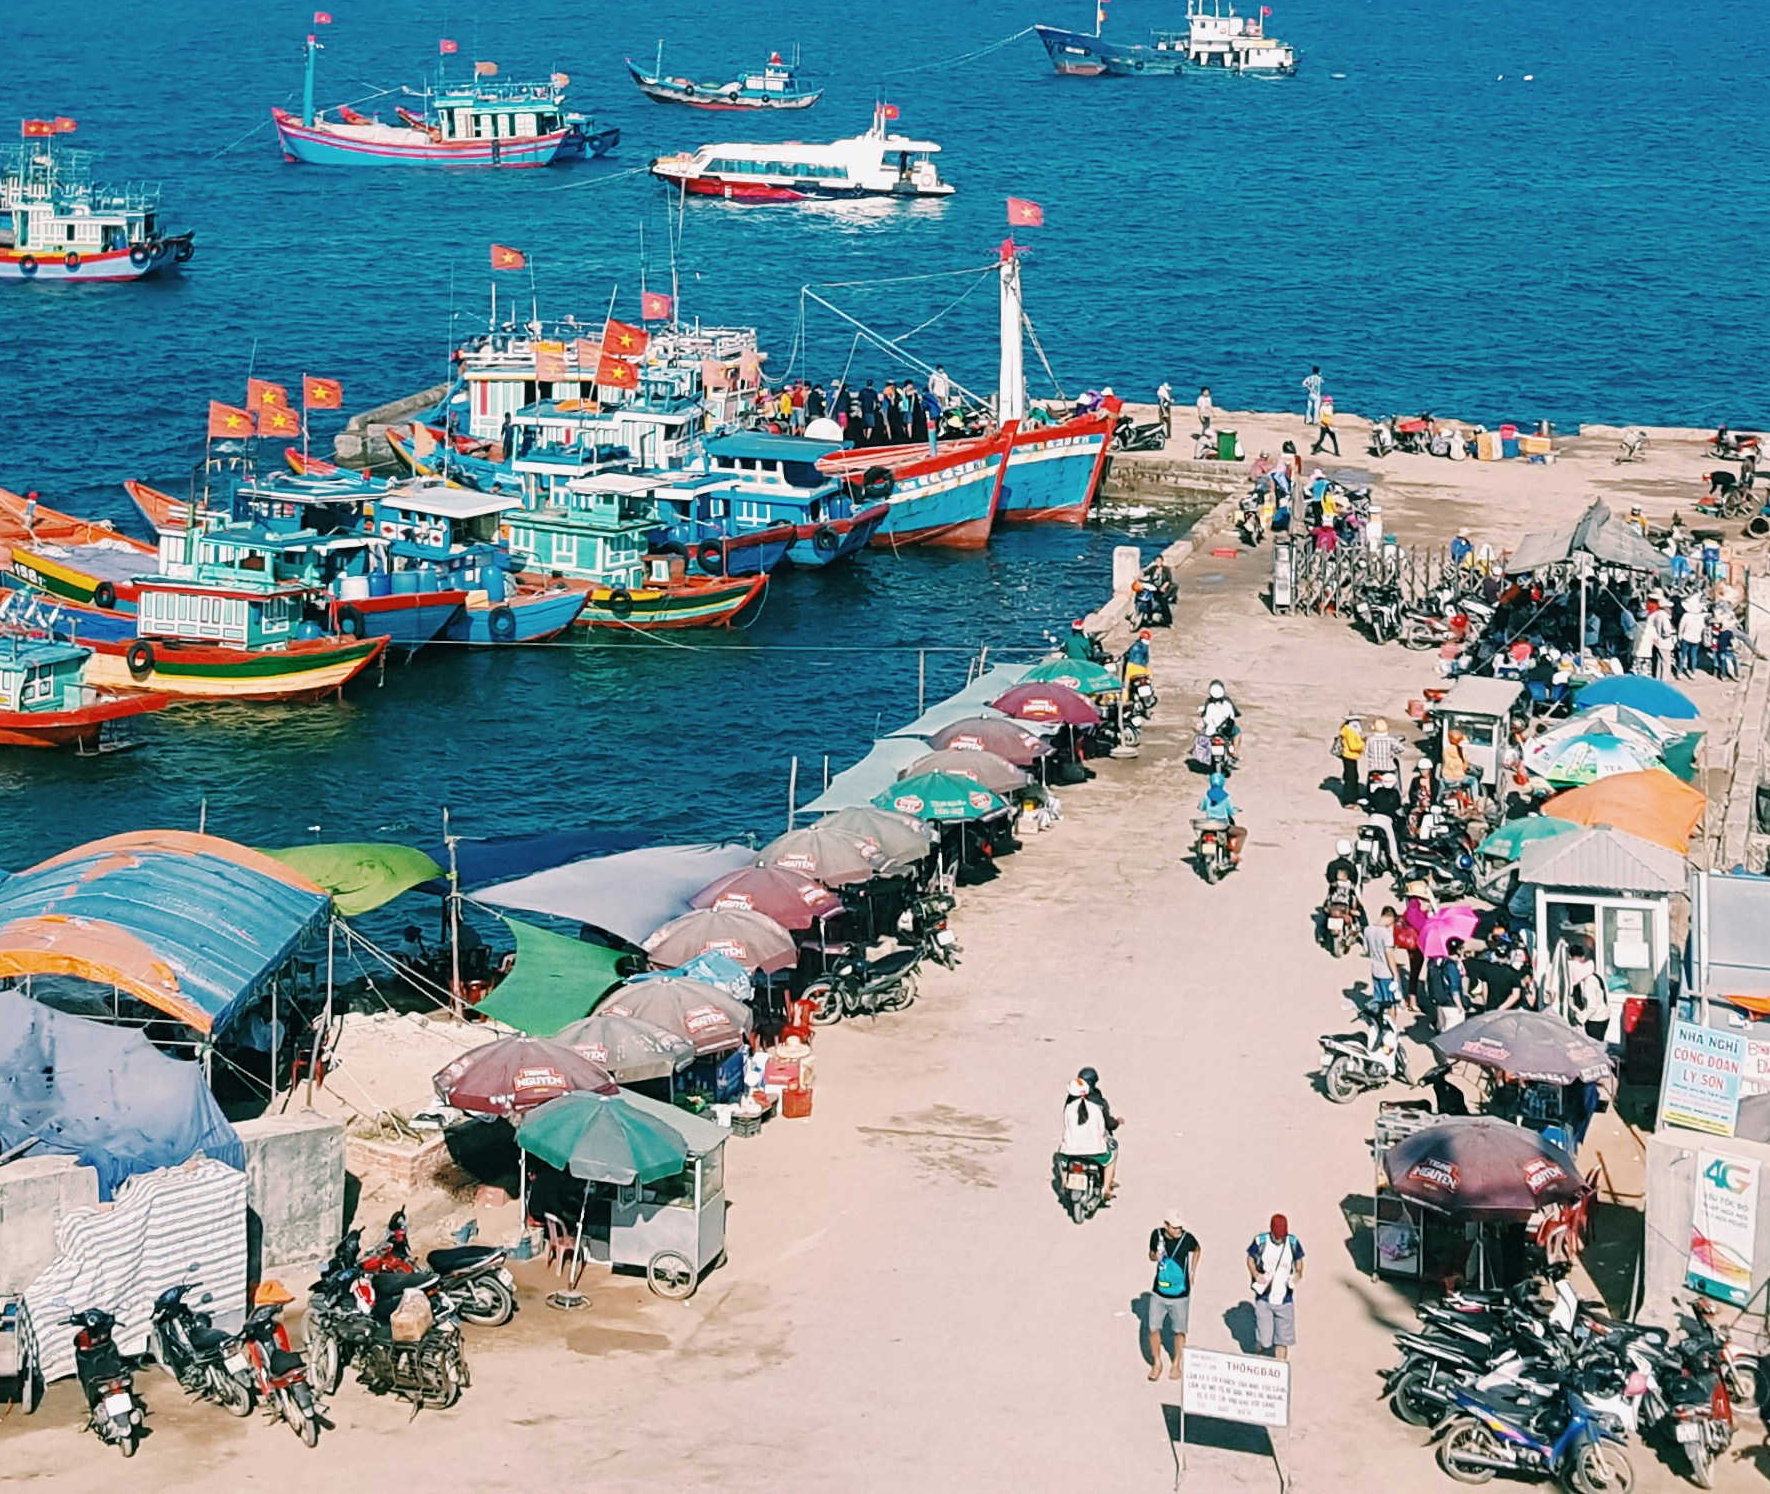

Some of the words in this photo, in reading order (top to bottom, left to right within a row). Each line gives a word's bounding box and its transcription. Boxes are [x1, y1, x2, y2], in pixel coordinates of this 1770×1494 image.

[1679, 1028, 1704, 1045] NHÀ
[1709, 1037, 1740, 1054] NGHỈ
[1674, 1045, 1704, 1066] CÔNG
[1683, 1067, 1698, 1083] LÝ
[1701, 1073, 1724, 1091] SƠN
[1703, 1158, 1751, 1195] 4G
